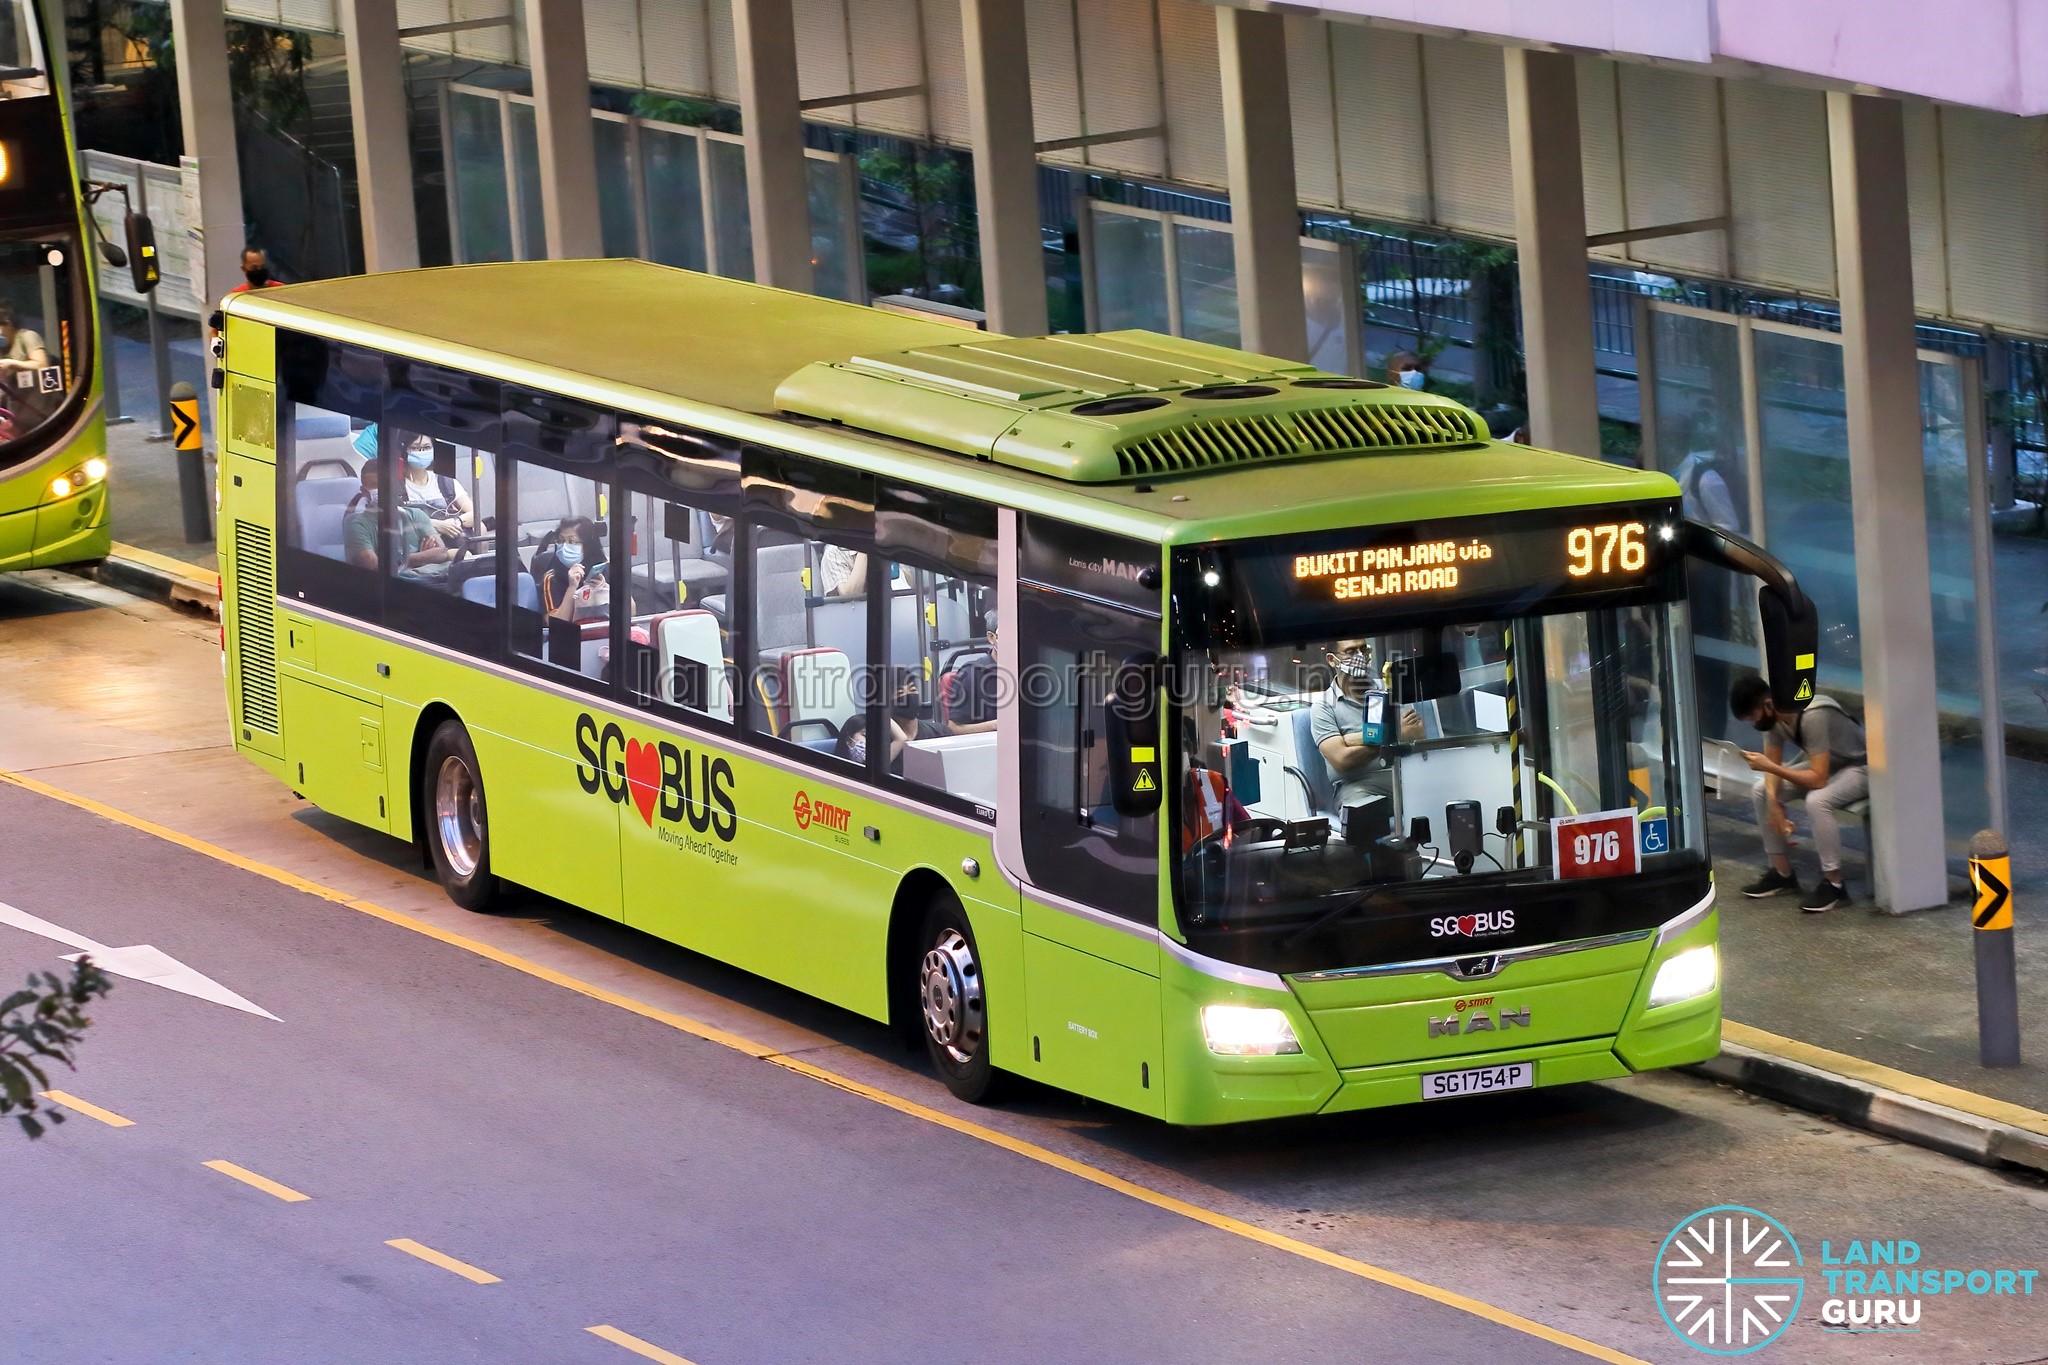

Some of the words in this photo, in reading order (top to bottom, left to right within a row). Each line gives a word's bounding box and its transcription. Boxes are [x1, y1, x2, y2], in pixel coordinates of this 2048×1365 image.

[1295, 551, 1359, 578] BUKIT
[1362, 541, 1456, 571] PANJANG
[1459, 539, 1492, 560] via
[1567, 522, 1645, 576] 976
[1102, 557, 1140, 581] MAN
[1334, 573, 1402, 599] SENJA
[1405, 566, 1458, 592] ROAD
[812, 800, 852, 832] SMRT
[657, 825, 684, 851] Moving
[684, 834, 707, 856] Ahead
[707, 842, 738, 867] Together
[1574, 830, 1620, 865] 976
[1468, 997, 1494, 1007] SMRT
[1428, 1005, 1531, 1038] MAN
[1434, 1066, 1521, 1094] SG1754P
